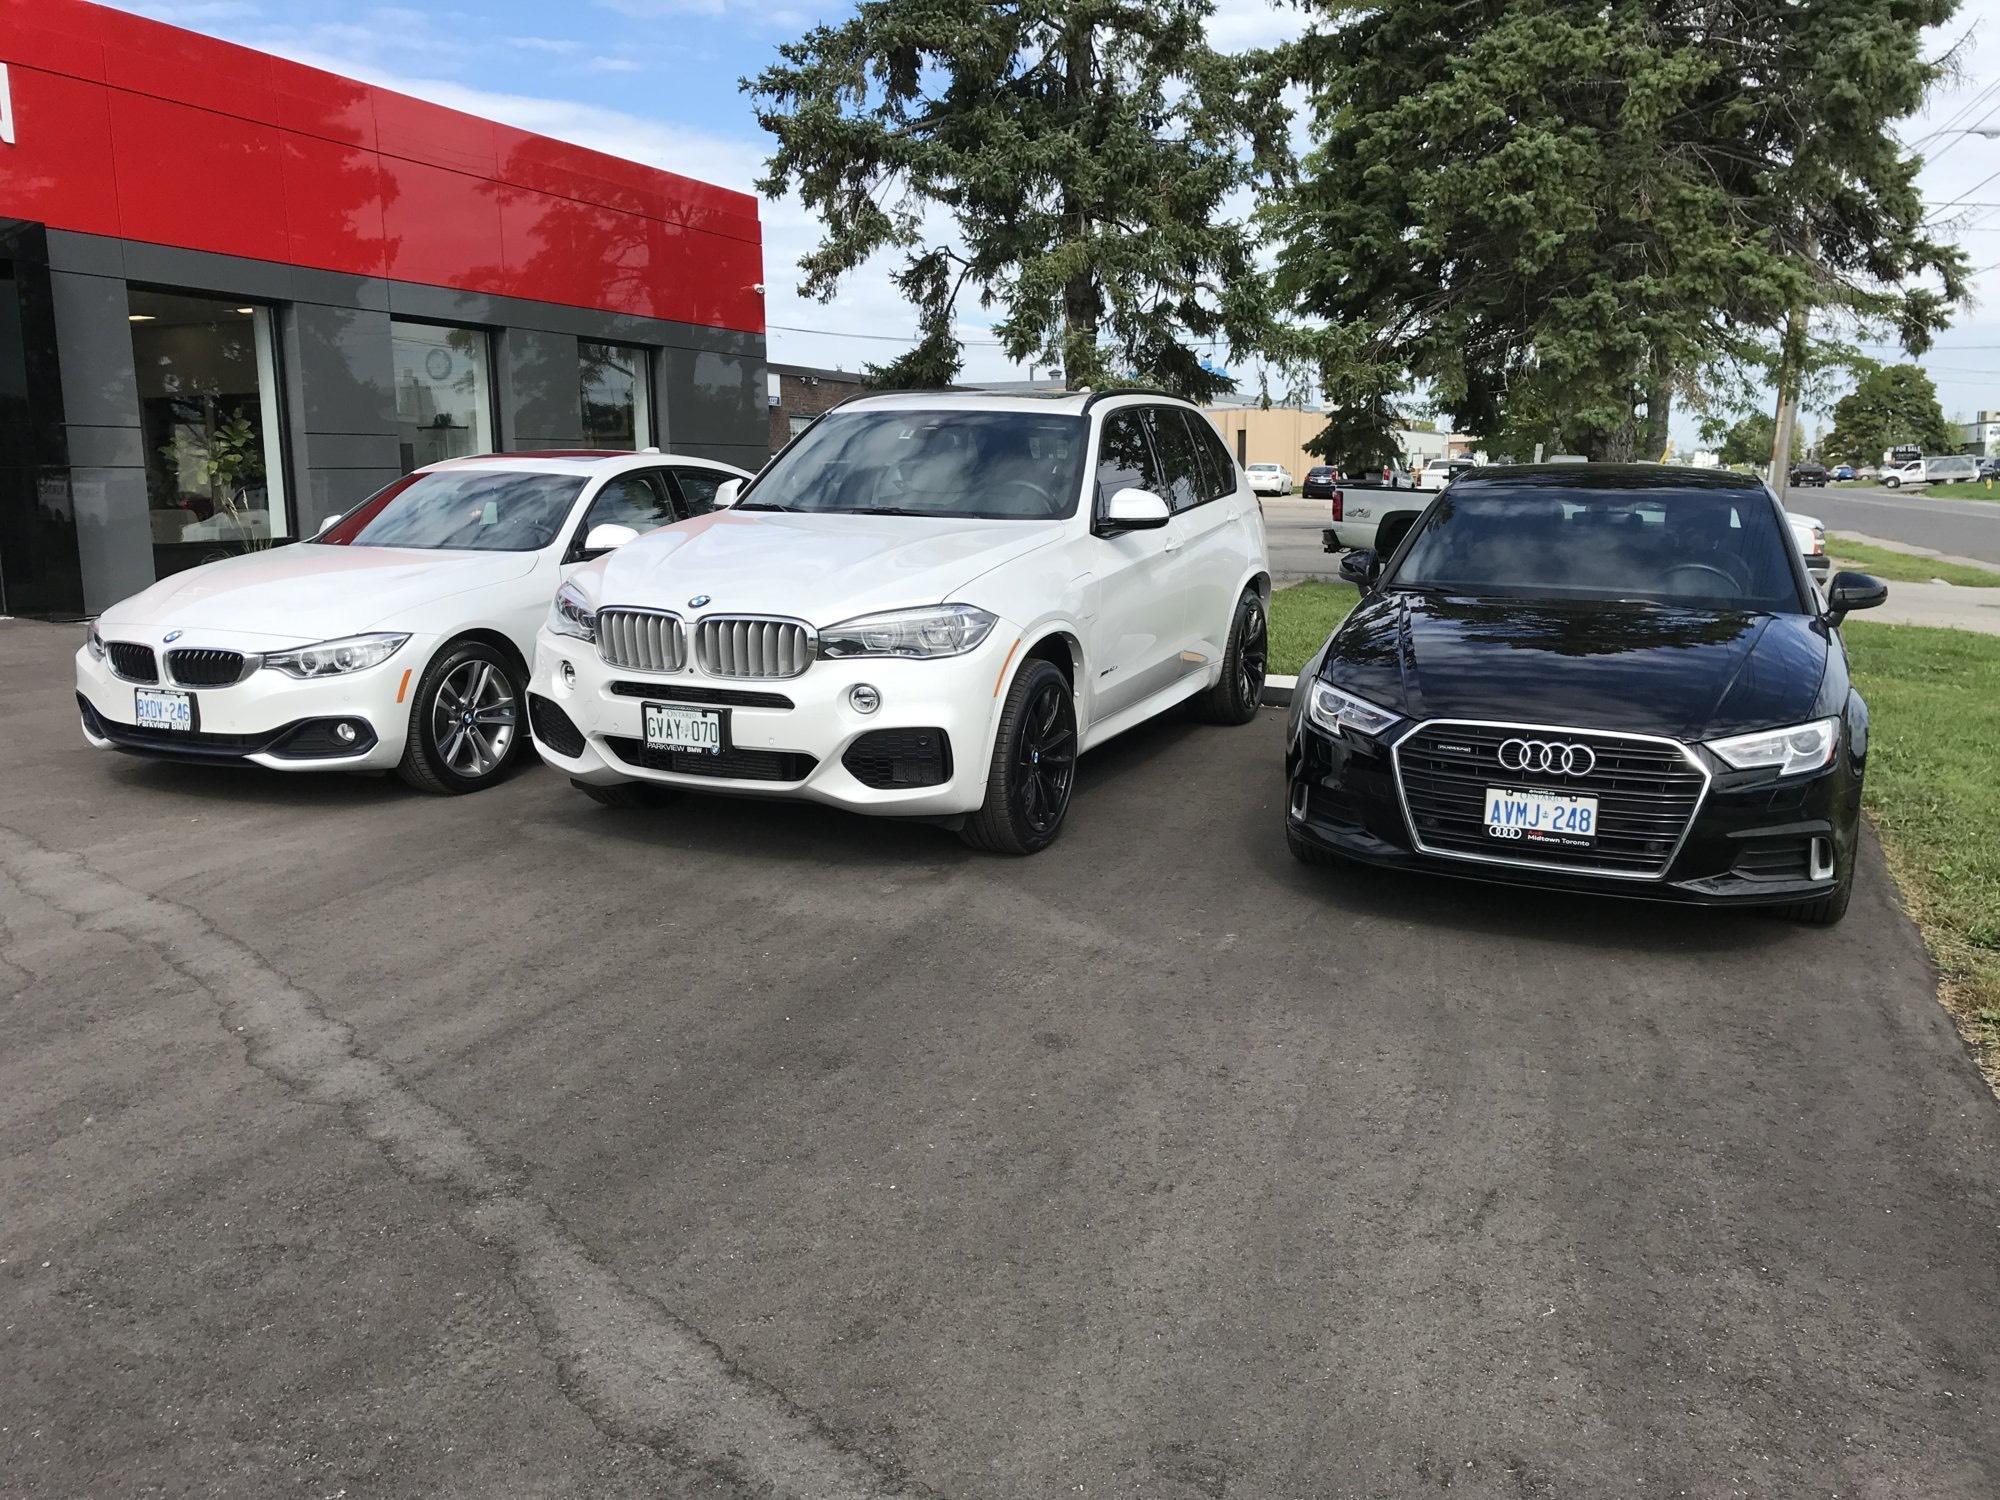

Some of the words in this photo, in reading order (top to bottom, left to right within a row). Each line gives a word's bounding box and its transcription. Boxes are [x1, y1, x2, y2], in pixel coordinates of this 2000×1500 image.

[170, 702, 190, 721] 246
[137, 718, 170, 729] Parkview
[171, 721, 190, 731] BMW
[648, 717, 681, 740] GVAY
[692, 721, 718, 743] 070
[647, 742, 685, 752] PARKVIEW
[1490, 799, 1541, 827] AVMJ
[1553, 806, 1592, 832] 248
[1527, 834, 1561, 843] Midtown
[1562, 837, 1590, 847] Toronto
